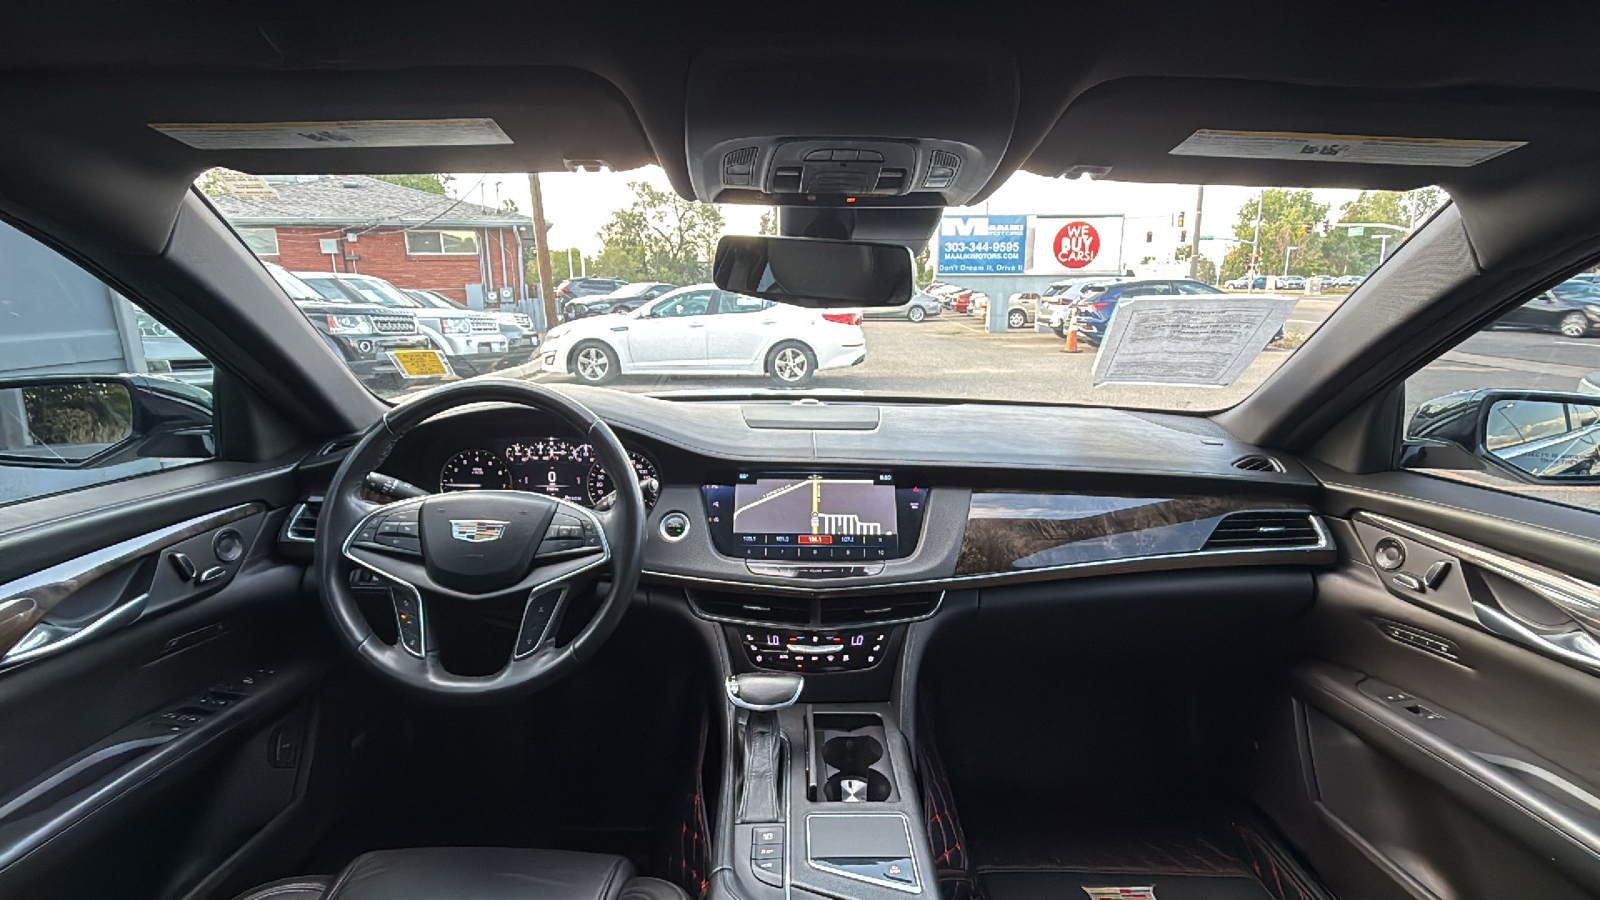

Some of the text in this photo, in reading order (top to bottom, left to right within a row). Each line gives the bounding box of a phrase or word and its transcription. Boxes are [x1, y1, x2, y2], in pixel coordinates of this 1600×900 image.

[1067, 225, 1089, 238] WE
[944, 241, 1020, 253] 303-344-9595
[1061, 236, 1093, 253] BUY
[944, 252, 1019, 260] MAALIKIMOTORS.COM
[1058, 250, 1094, 262] CARS!
[547, 471, 557, 482] 0
